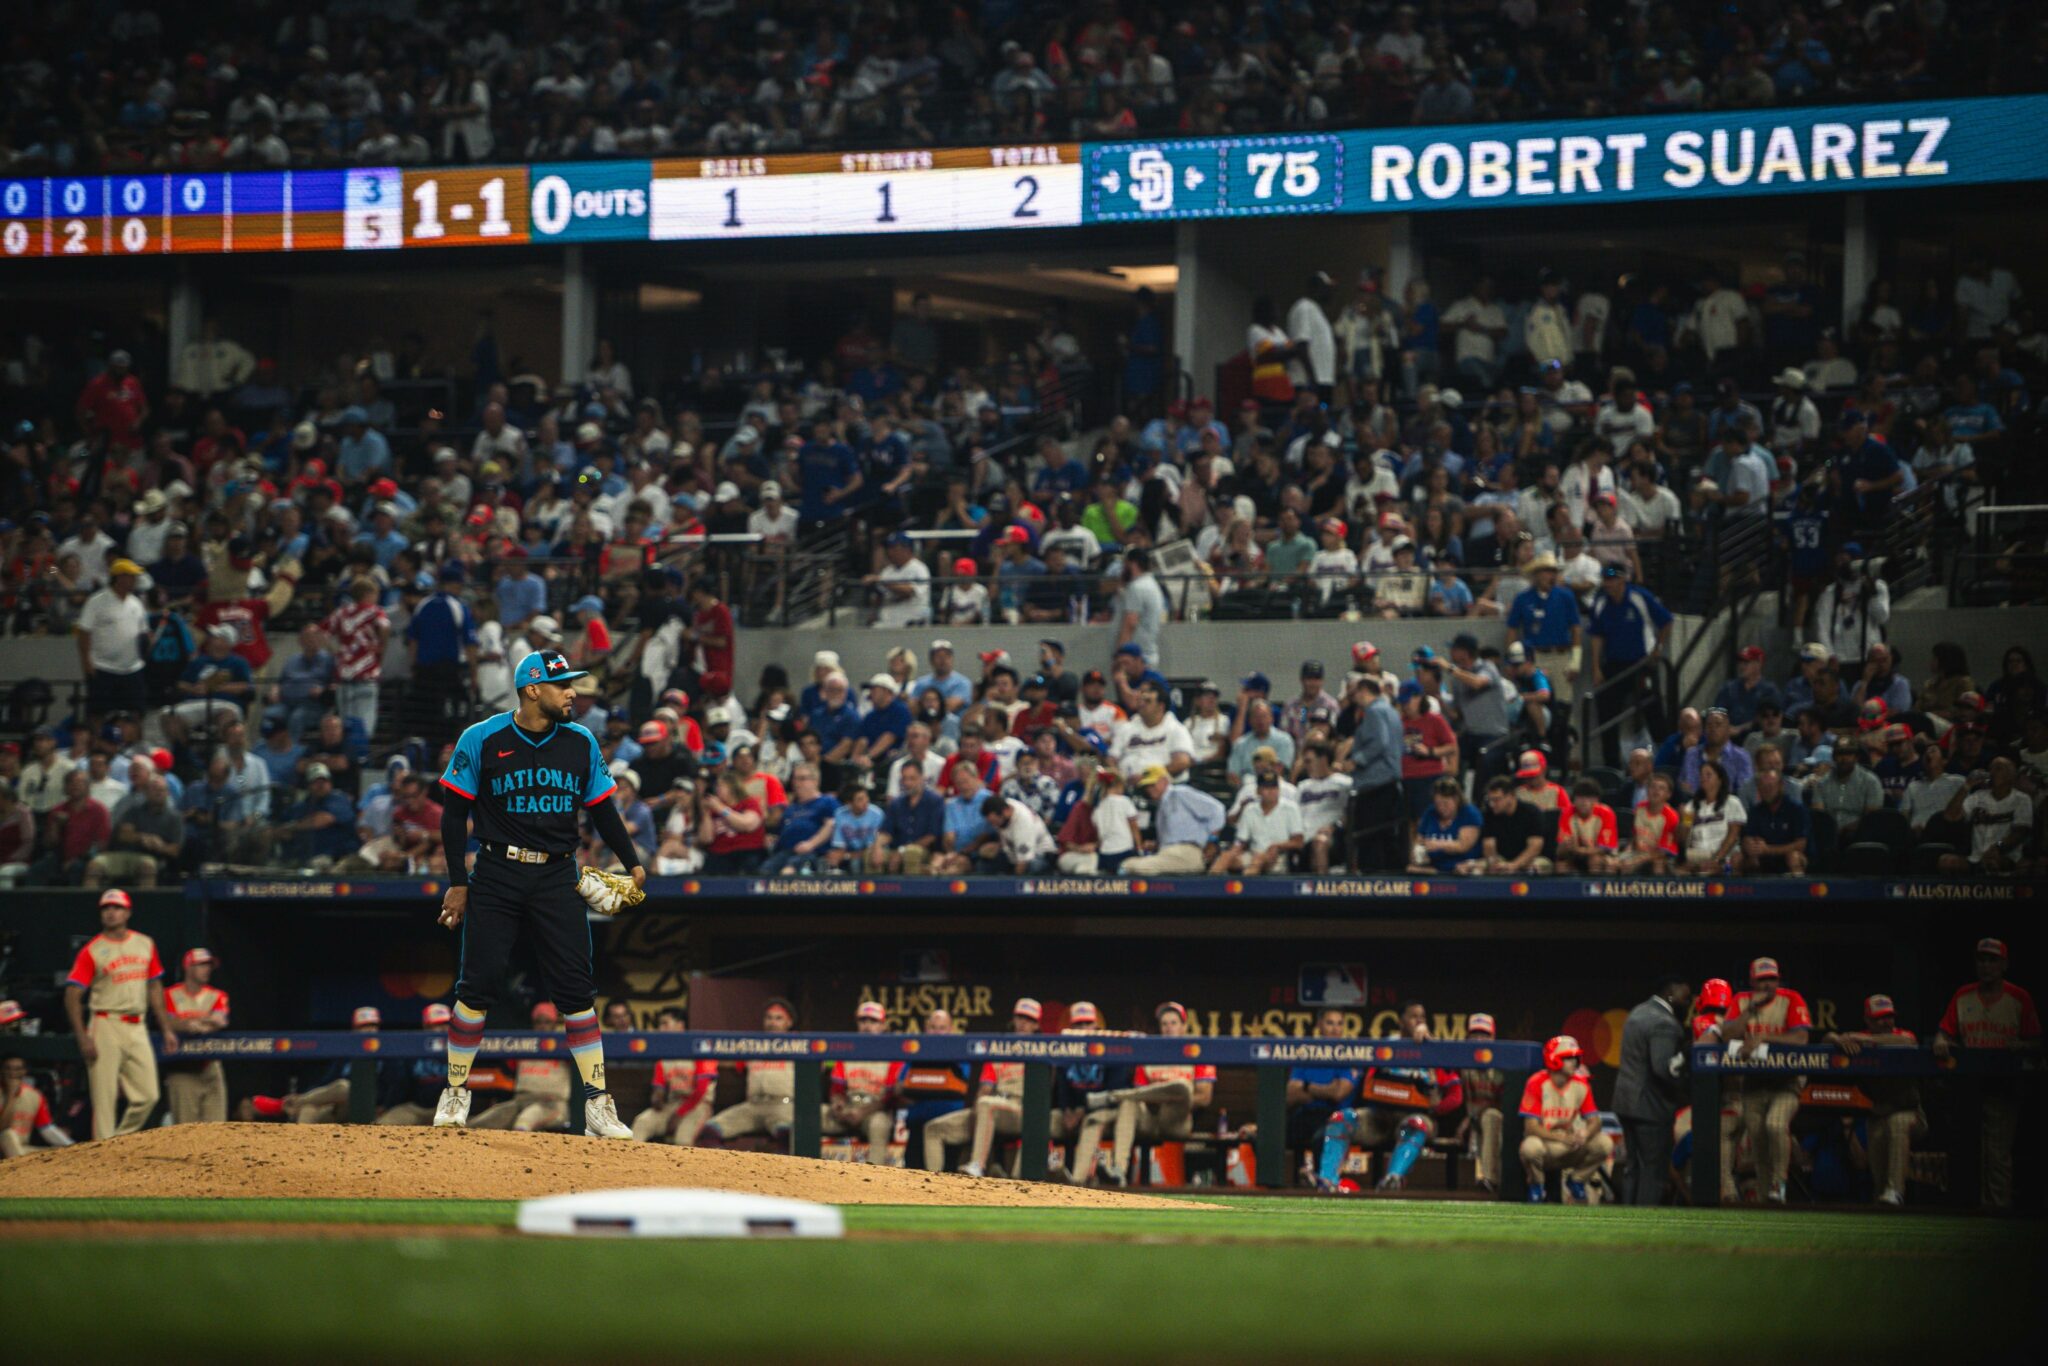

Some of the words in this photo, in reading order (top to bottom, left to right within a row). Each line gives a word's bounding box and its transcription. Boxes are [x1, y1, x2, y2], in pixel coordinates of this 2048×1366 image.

[991, 146, 1061, 167] TOTAL
[1371, 133, 1647, 202] ROBERT
[1663, 117, 1950, 188] SUAREZ
[1247, 150, 1320, 199] 75
[4, 182, 27, 215] 0
[63, 181, 86, 214] 0
[122, 179, 146, 212] 0
[182, 178, 206, 211] 0
[363, 175, 382, 203] 3
[876, 181, 896, 223] 1
[1013, 175, 1039, 218] 2
[531, 175, 572, 235] 0
[572, 188, 647, 218] OUTS
[723, 187, 743, 228] 1
[4, 221, 29, 255] 0
[63, 219, 88, 254] 2
[121, 217, 147, 252] 0
[364, 215, 381, 242] 5
[491, 767, 581, 795] NATIONAL
[506, 795, 573, 813] LEAGUE
[824, 880, 858, 895] GAME
[1094, 880, 1131, 895] GAME
[1373, 881, 1411, 896] GAME
[1666, 881, 1705, 898] GAME
[1971, 882, 2014, 900] GAME
[773, 1038, 809, 1054] GAME
[1050, 1040, 1088, 1056] GAME
[1334, 1043, 1374, 1060] GAME
[1786, 1051, 1829, 1069] GAME
